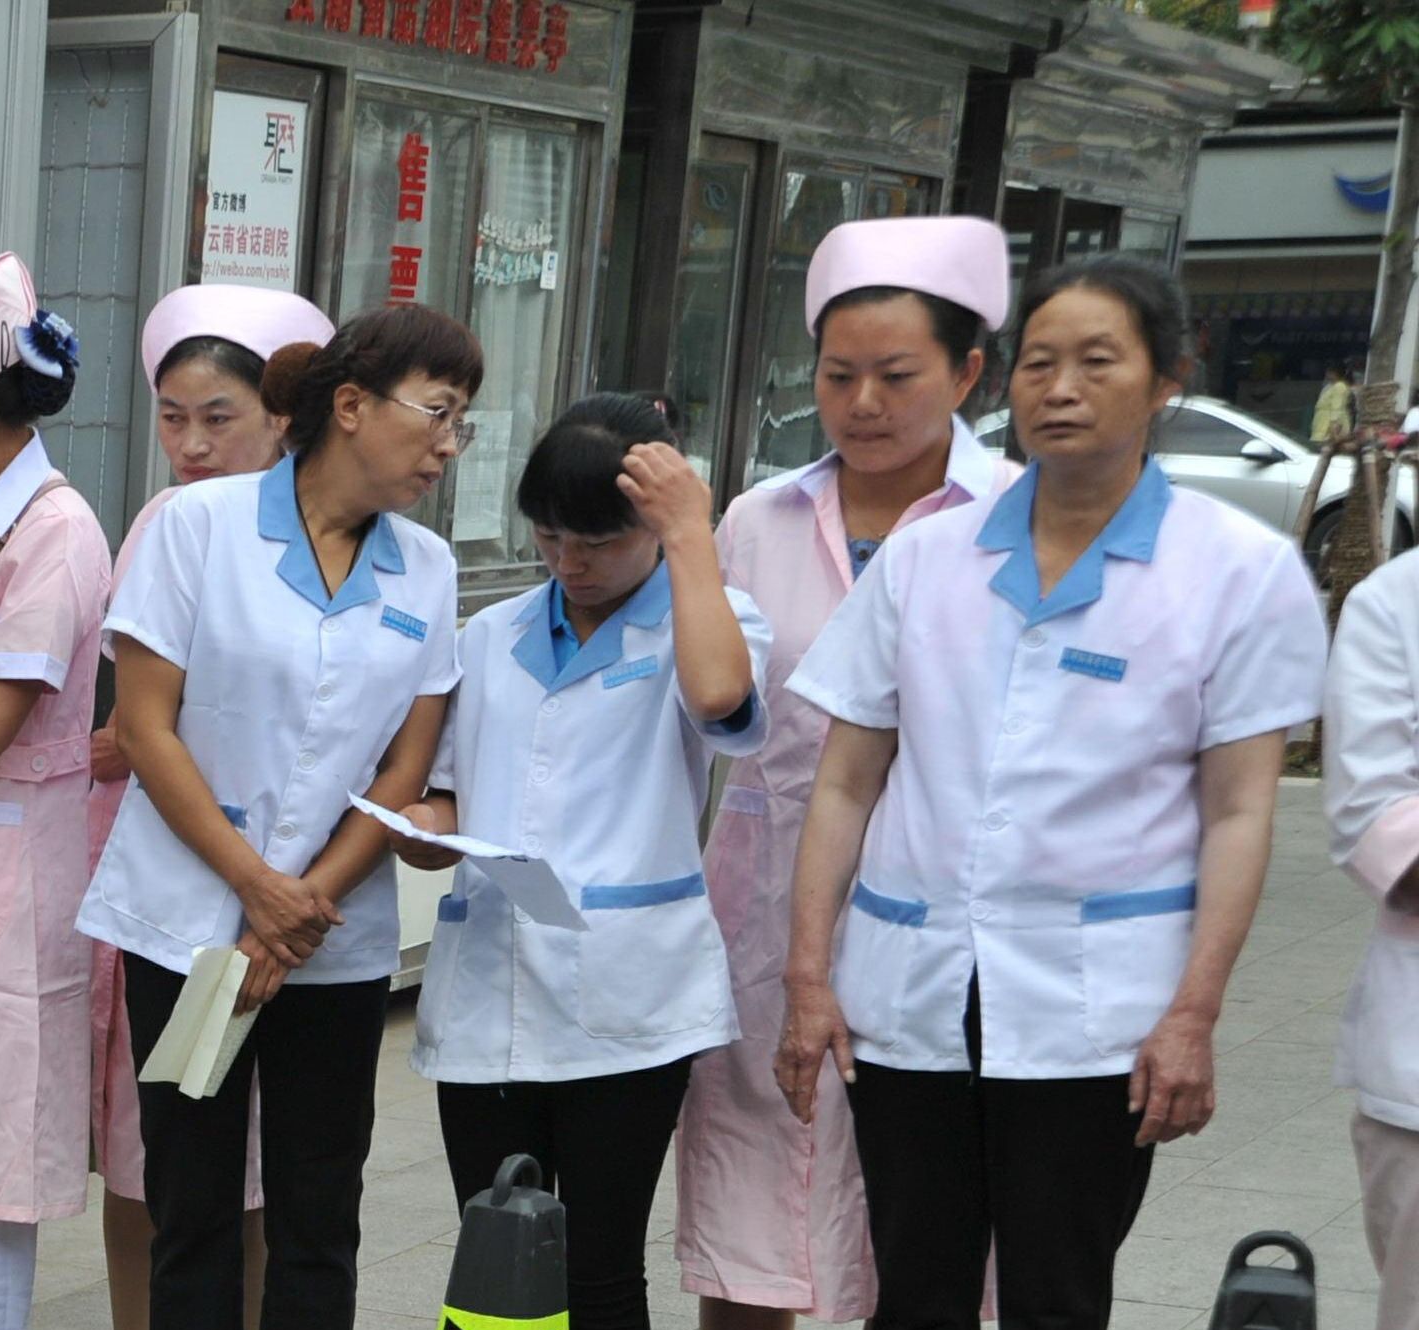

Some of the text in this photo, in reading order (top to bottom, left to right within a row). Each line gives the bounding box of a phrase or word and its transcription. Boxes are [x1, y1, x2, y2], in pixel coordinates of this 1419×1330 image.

[212, 191, 246, 213] 官方微博
[208, 223, 289, 257] 云南省话剧院
